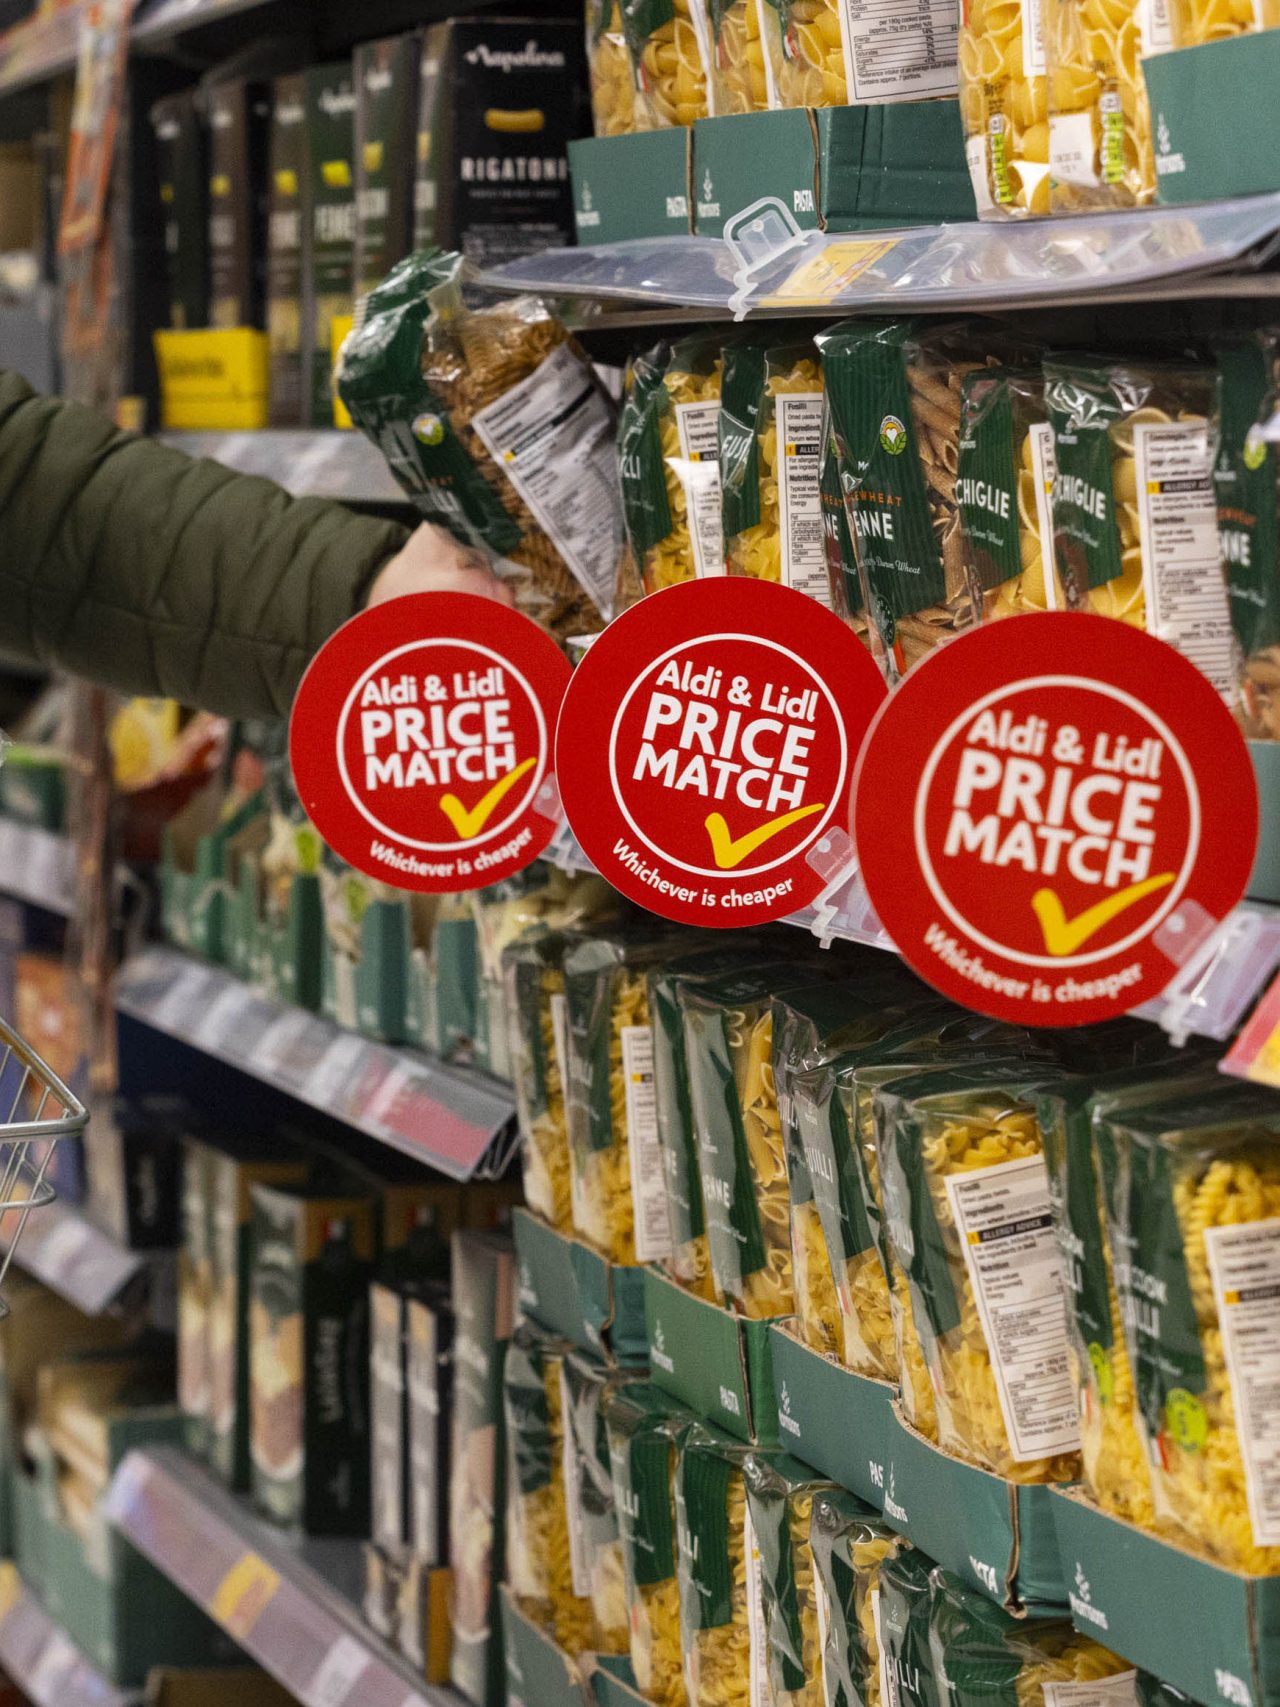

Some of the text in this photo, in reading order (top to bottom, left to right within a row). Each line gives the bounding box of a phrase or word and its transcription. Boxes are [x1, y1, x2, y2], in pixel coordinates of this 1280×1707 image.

[460, 156, 568, 182] RIGATONI
[955, 477, 1011, 520] CHIGLIE
[360, 667, 505, 708] Aldi & Lidl
[656, 660, 819, 723] Aldi & Lidl
[361, 700, 515, 755] PRICE
[642, 691, 817, 778] PRICE
[966, 709, 1165, 780] Aldi & Lidl
[365, 744, 516, 791] MATCH
[631, 743, 806, 812] MATCH
[952, 748, 1162, 846] PRICE
[369, 826, 533, 878] Whichever is cheaper
[612, 838, 794, 909] Whichever is cheaper
[943, 809, 1154, 889] MATCH
[922, 922, 1144, 1003] Whichever is cheaper
[982, 1226, 1015, 1240] ALLERGY
[869, 1460, 884, 1488] PAS
